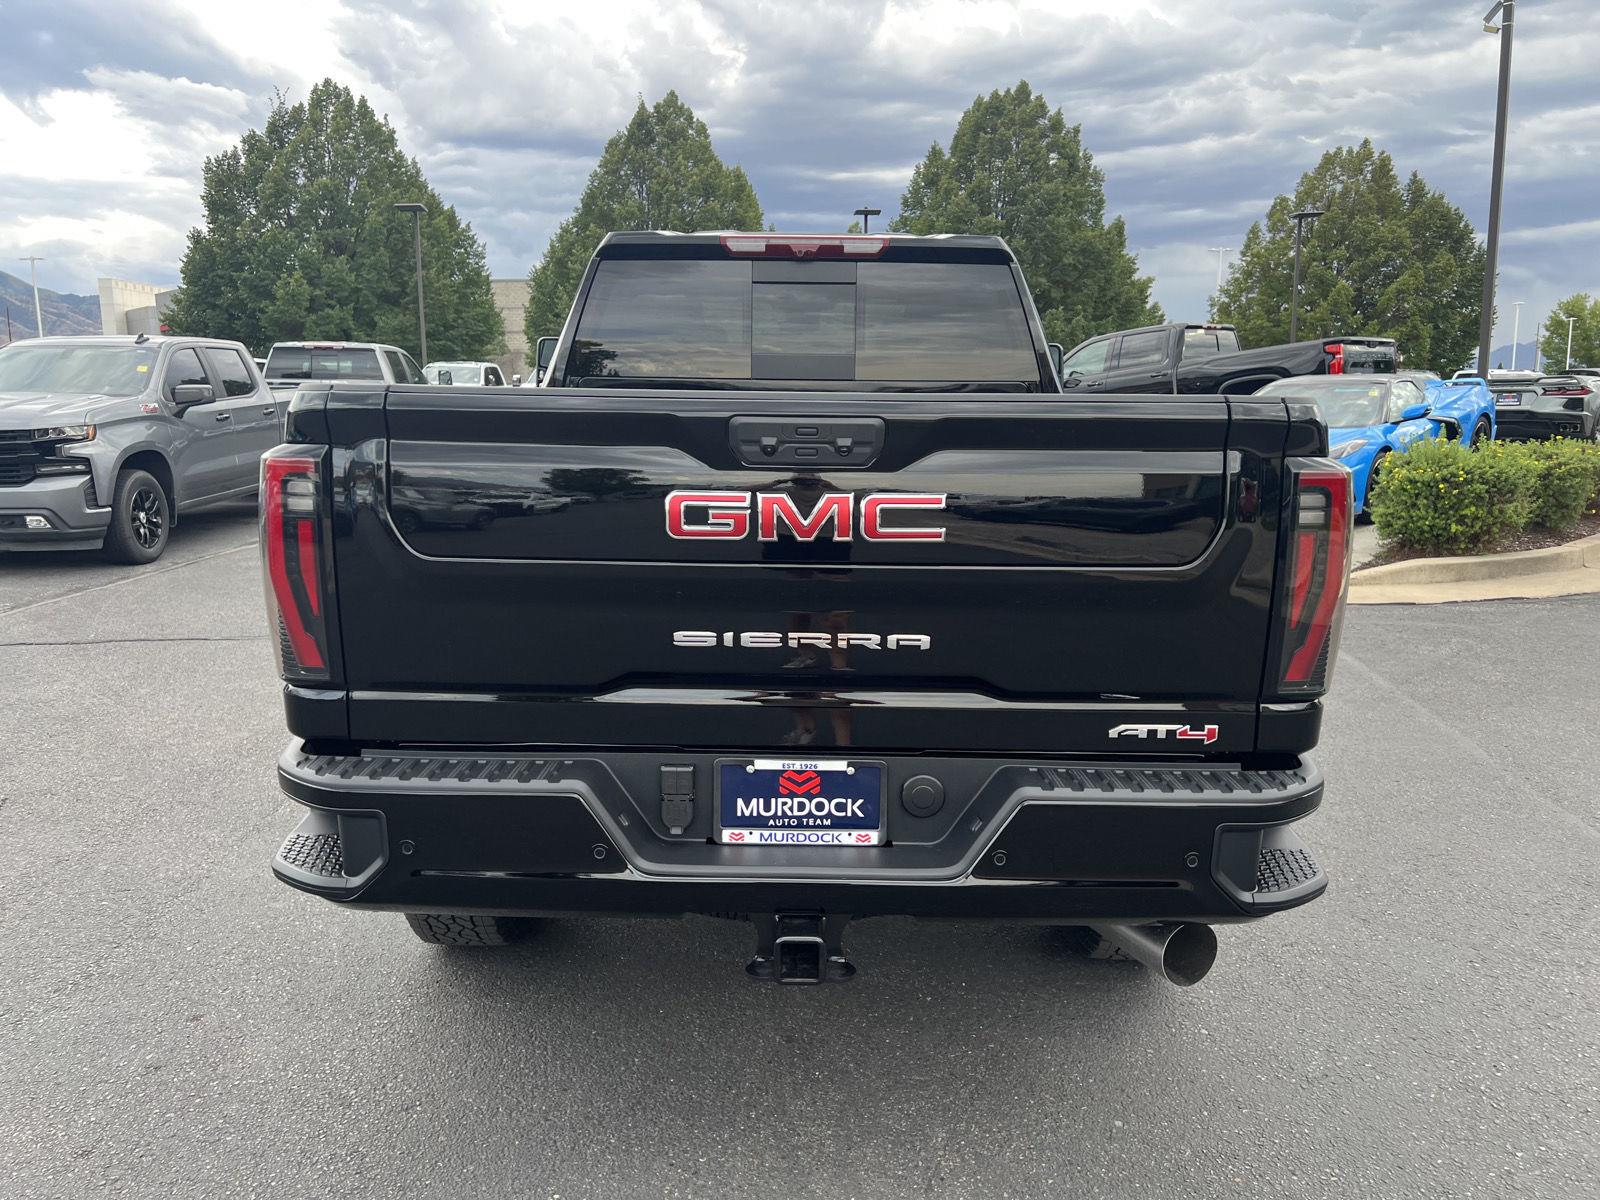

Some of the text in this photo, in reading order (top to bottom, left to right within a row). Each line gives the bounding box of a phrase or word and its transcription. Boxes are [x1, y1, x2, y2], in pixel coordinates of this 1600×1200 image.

[664, 489, 948, 542] GMC
[673, 630, 932, 651] SIERRA
[1108, 723, 1219, 745] AT4
[782, 762, 798, 770] EST.
[736, 797, 865, 818] MURDOCK
[768, 818, 831, 827] AUTO TEAM
[759, 832, 842, 843] MURDOCK
